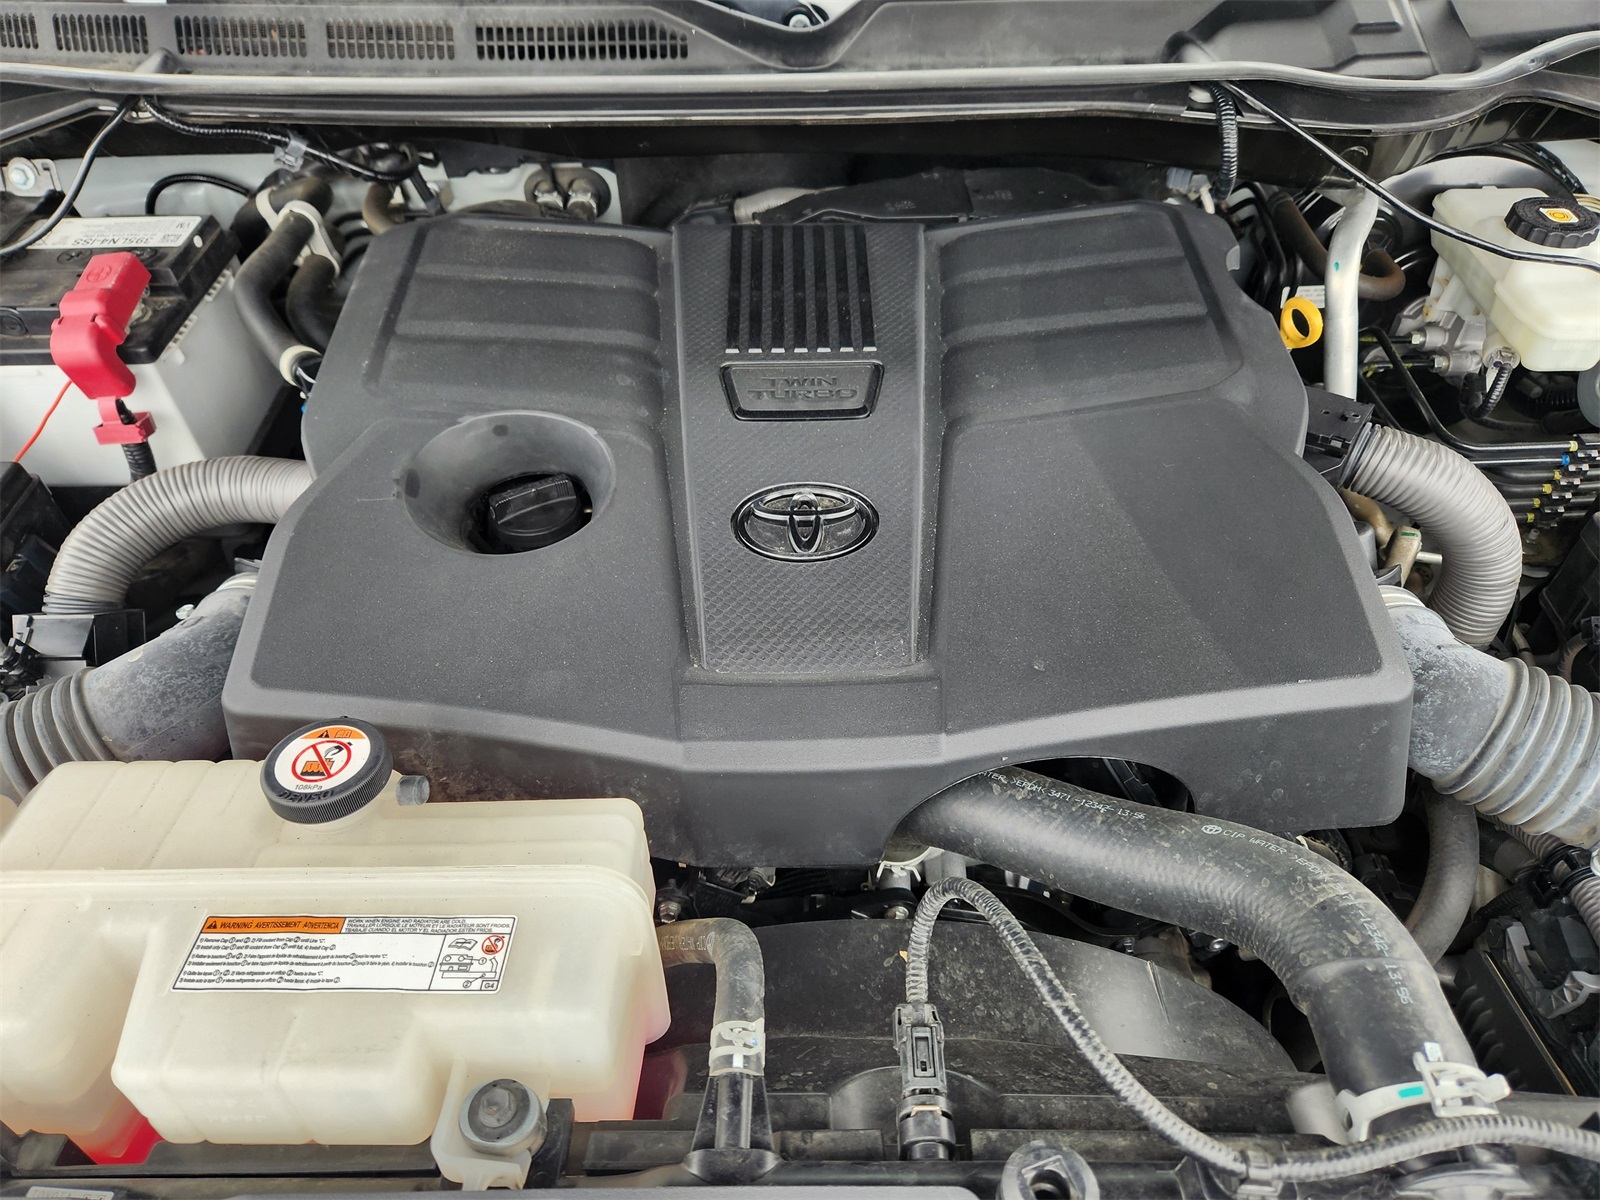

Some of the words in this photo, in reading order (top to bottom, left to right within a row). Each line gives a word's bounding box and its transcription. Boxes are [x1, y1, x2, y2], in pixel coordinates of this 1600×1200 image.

[761, 375, 838, 387] TWIN
[747, 388, 858, 400] TURBO
[276, 789, 333, 803] DENSO
[978, 771, 1008, 784] ATER
[1048, 789, 1071, 802] 3471
[1118, 808, 1147, 820] 13:56
[1223, 829, 1246, 839] CIP
[1248, 837, 1288, 855] WATER
[1385, 964, 1414, 1005] 13:56
[255, 921, 302, 929] AVERTISSEMENT
[302, 922, 339, 930] ADVERTENCIA
